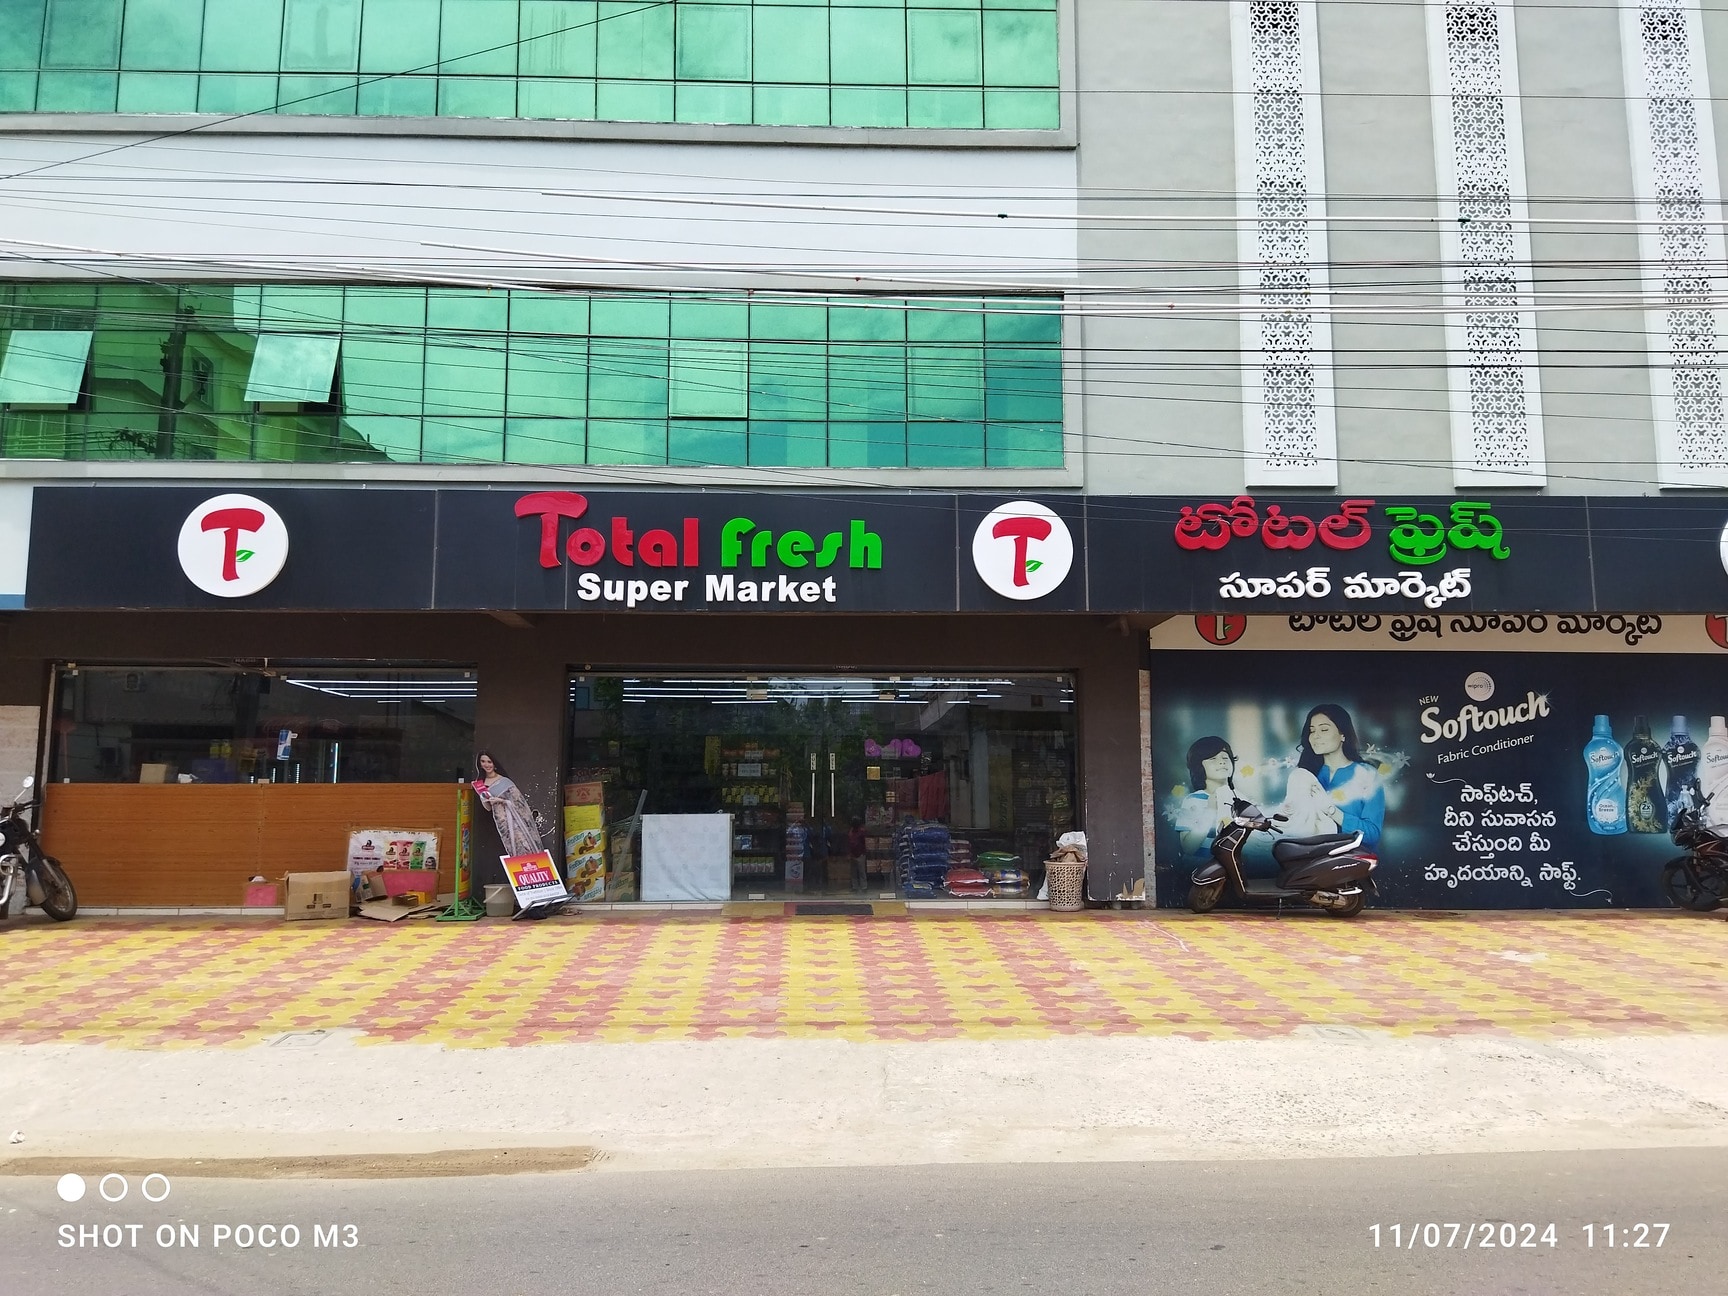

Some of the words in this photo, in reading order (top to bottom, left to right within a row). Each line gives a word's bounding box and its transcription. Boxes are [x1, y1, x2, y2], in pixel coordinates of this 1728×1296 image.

[201, 507, 265, 581] T
[514, 491, 699, 568] Total
[721, 517, 883, 569] fresh
[1175, 495, 1376, 551] టోటల్
[1384, 501, 1511, 566] ఫ్రెష్
[992, 517, 1052, 587] T
[577, 572, 689, 608] Super
[705, 574, 837, 603] Market
[1219, 567, 1332, 599] సూపర్
[1343, 567, 1472, 609] మార్కెట్
[1419, 695, 1439, 706] NEW
[1420, 691, 1550, 744] Softouch
[1437, 748, 1470, 765] Fabric
[1471, 733, 1535, 756] Conditioner
[1632, 751, 1659, 764] Softouch
[1667, 751, 1698, 764] Softouch
[1443, 806, 1474, 827] దీని
[1481, 809, 1557, 827] సువాసన
[1452, 830, 1522, 860] చేస్తుంది
[1529, 832, 1551, 852] మీ
[519, 871, 550, 885] QUALITY
[1424, 863, 1534, 889] హృదయాన్ని
